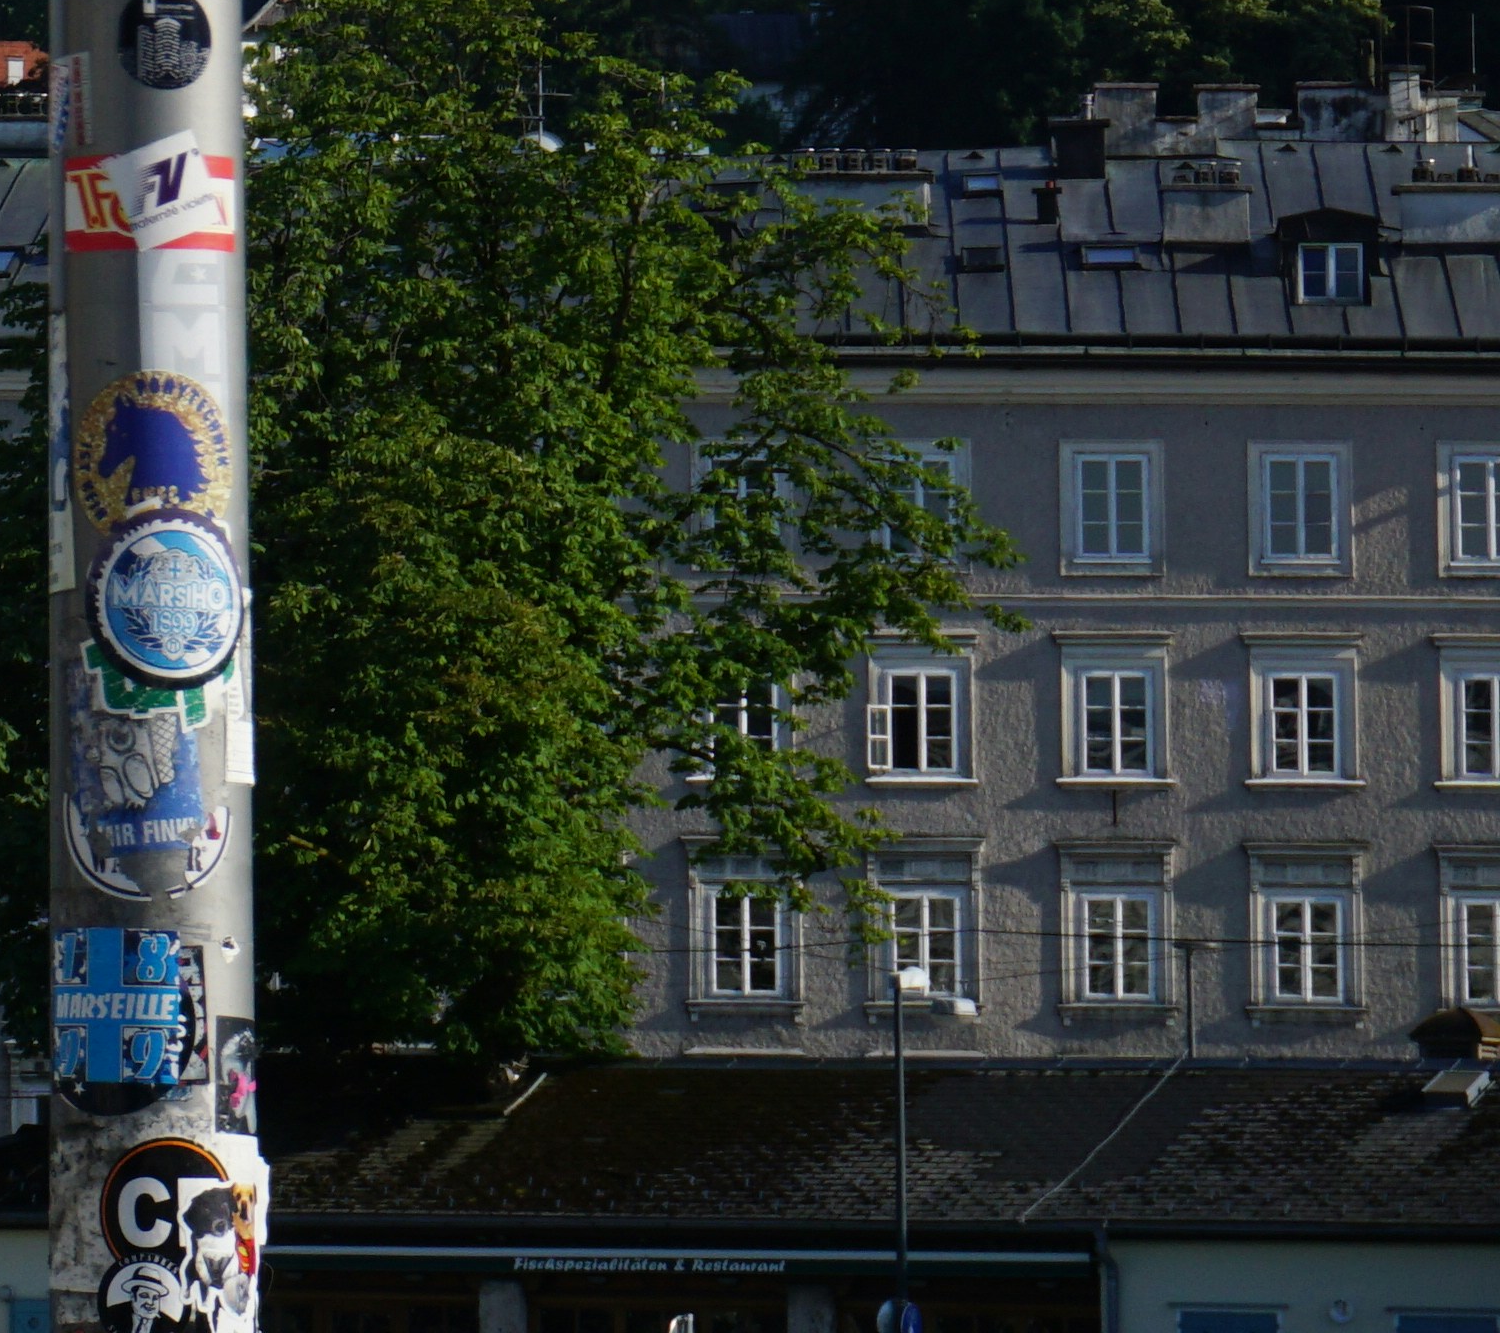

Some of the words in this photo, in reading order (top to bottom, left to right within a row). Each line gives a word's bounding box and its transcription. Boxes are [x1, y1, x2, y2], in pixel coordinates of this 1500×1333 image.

[150, 610, 198, 634] 1899
[136, 933, 170, 983] 8
[56, 993, 177, 1021] MARSEILLE
[131, 1028, 167, 1079] 9
[513, 1257, 668, 1272] Fischspezialitäten
[674, 1259, 685, 1271] &
[692, 1259, 786, 1273] Restaurant
